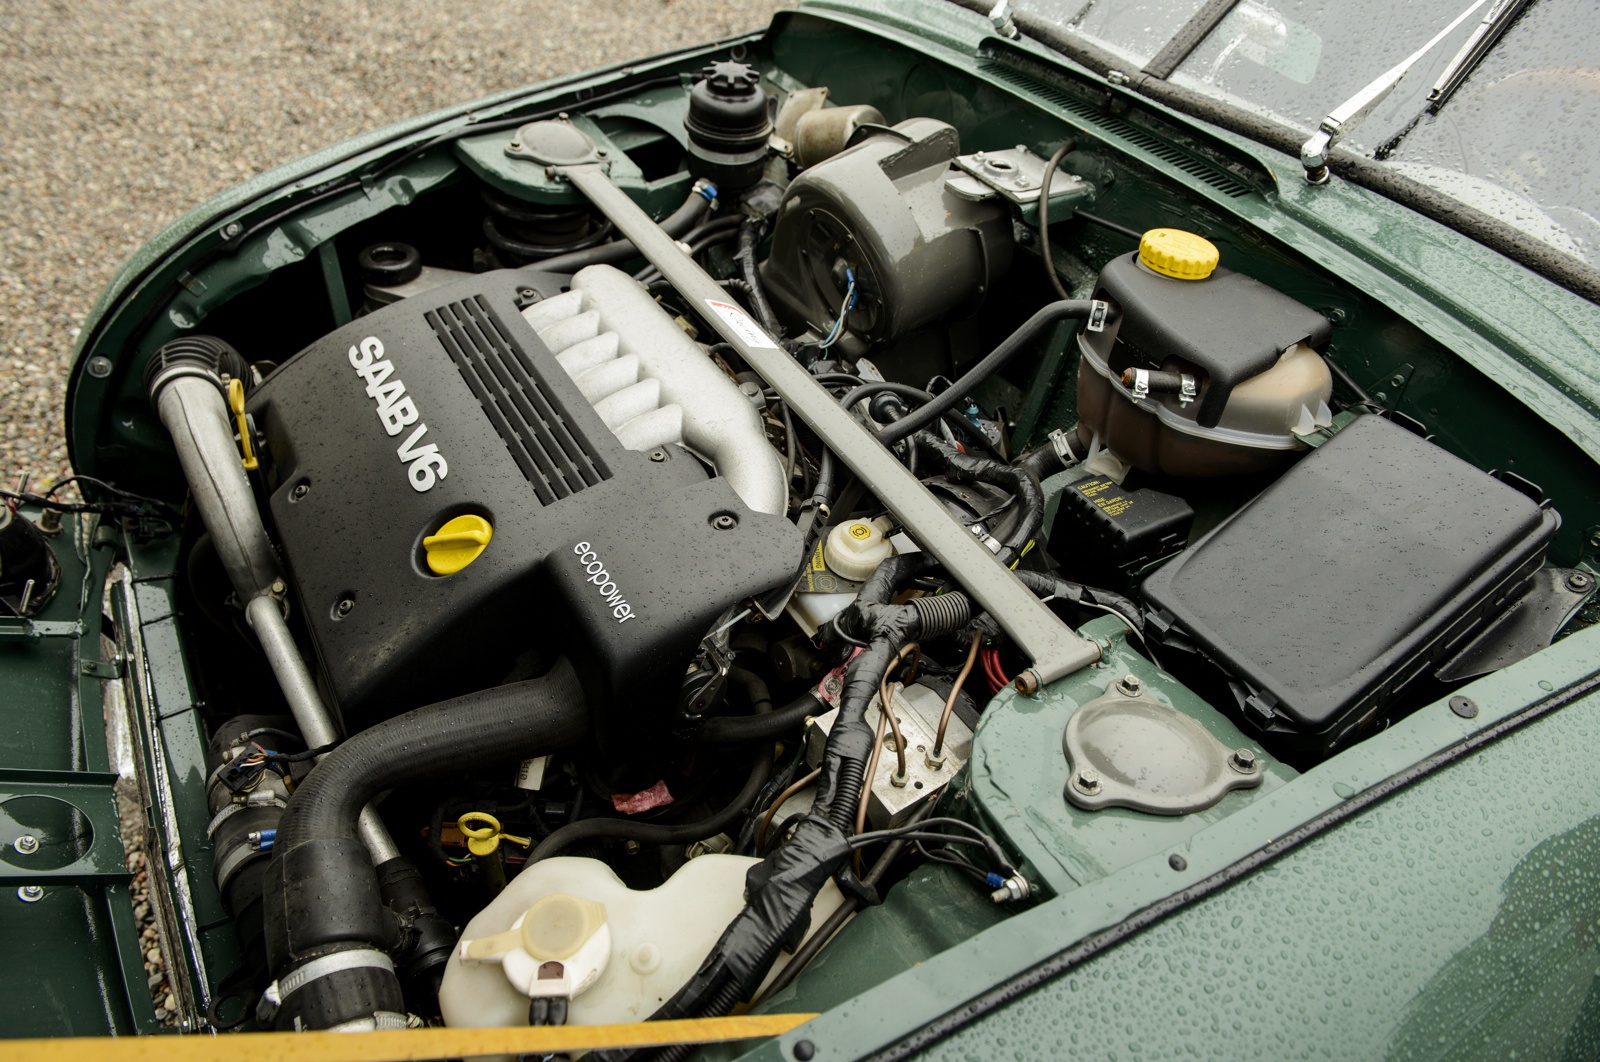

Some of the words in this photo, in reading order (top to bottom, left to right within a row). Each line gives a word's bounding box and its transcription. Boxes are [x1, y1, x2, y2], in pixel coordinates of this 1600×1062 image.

[347, 336, 420, 437] SAAB
[396, 422, 449, 493] V6
[573, 541, 636, 624] ecopower
